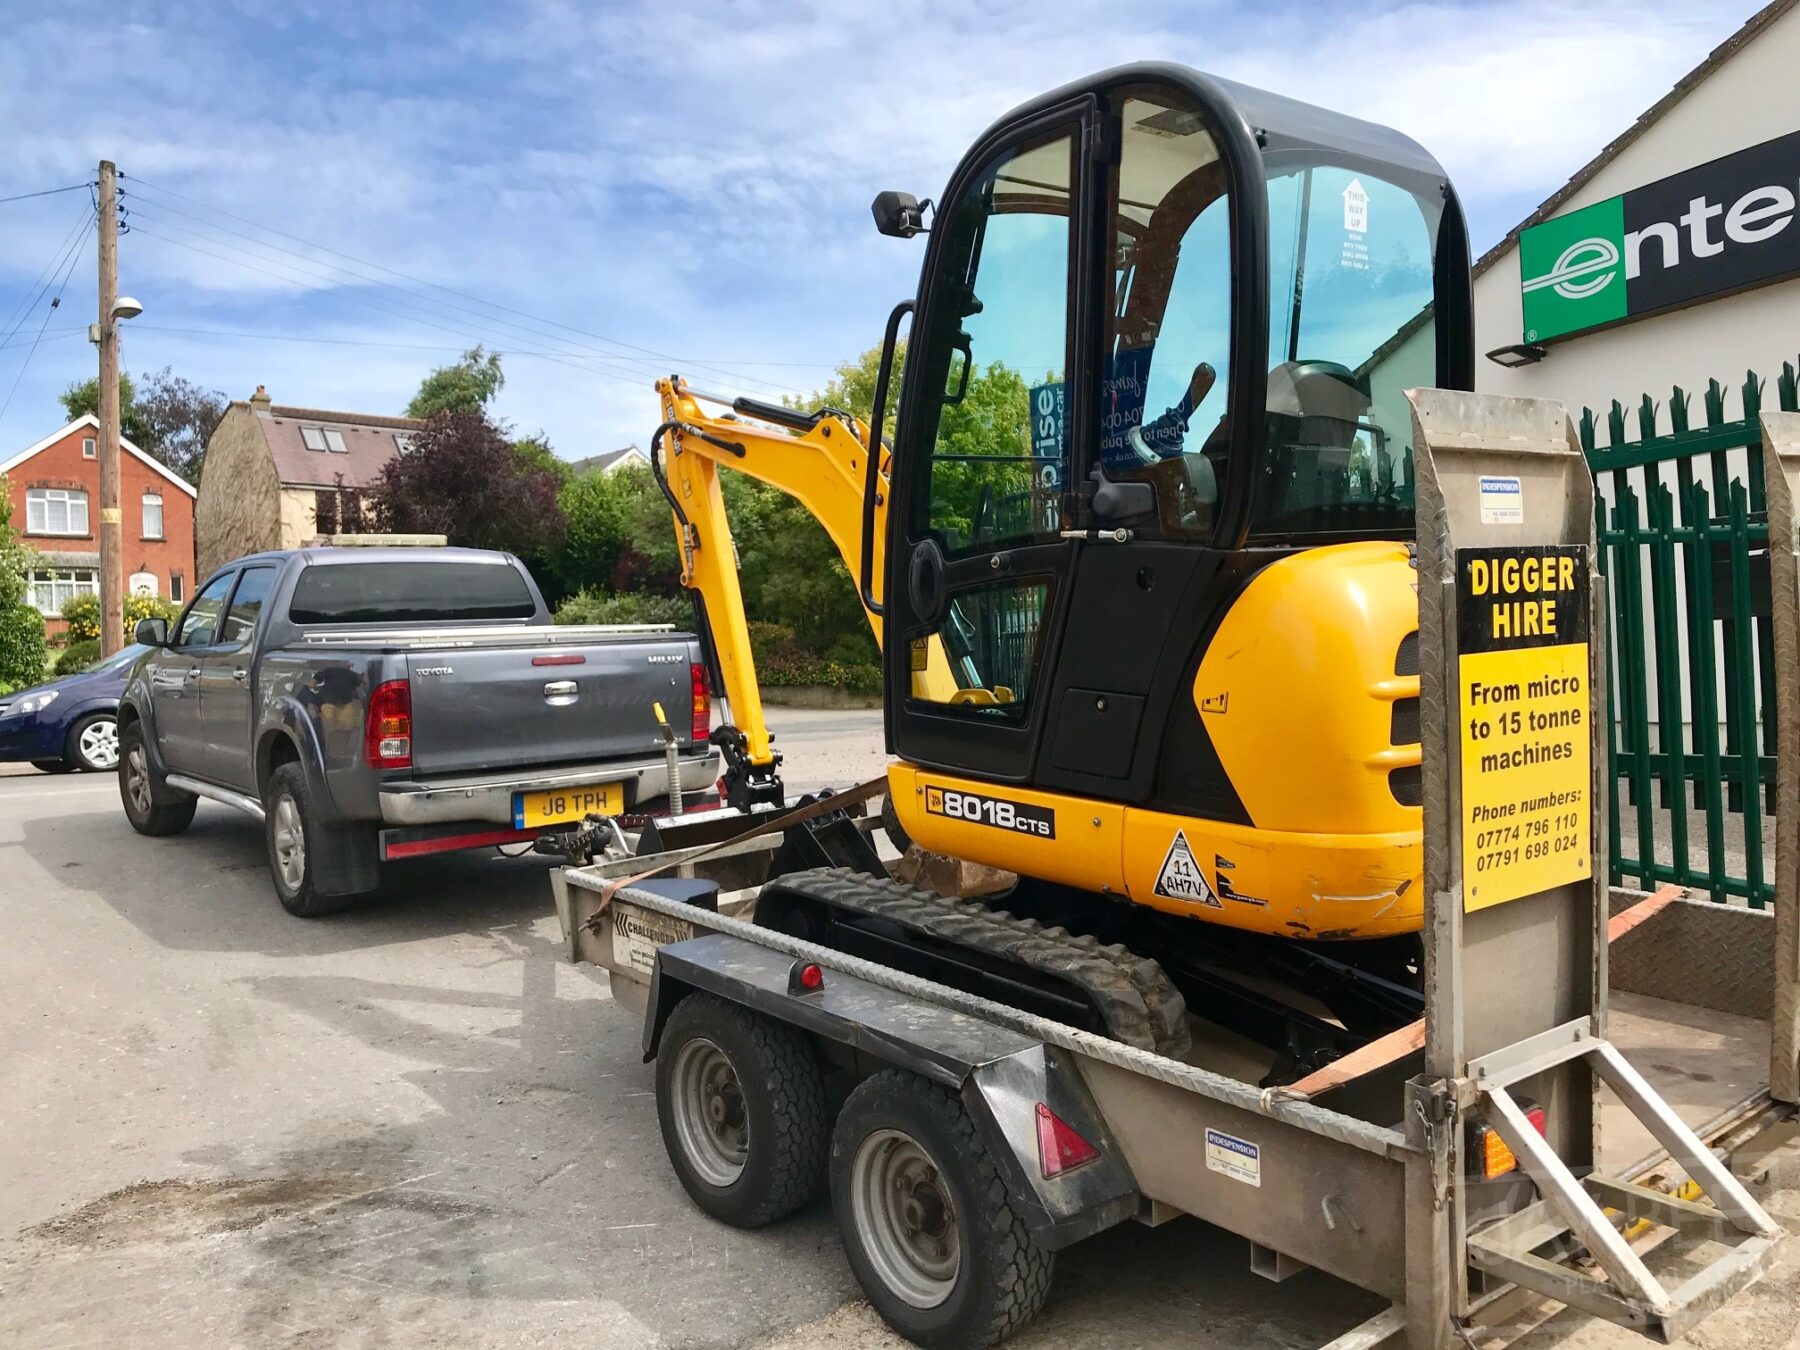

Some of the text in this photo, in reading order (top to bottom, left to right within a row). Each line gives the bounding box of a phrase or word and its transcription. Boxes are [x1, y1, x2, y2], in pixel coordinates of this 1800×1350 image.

[1348, 191, 1364, 202] THIS
[1349, 205, 1363, 215] WAY
[1351, 218, 1361, 228] UP
[1522, 185, 1800, 299] ente
[1471, 557, 1575, 595] DIGGER
[1493, 600, 1557, 639] HIRE
[416, 666, 454, 677] TOYOTA
[1470, 674, 1580, 706] From micro
[1470, 708, 1581, 741] to 15 tonne
[1481, 741, 1573, 773] machines
[542, 791, 607, 816] J8 TPH
[1472, 789, 1582, 823] Phone numbers:
[1476, 812, 1578, 849] 07774 796 110
[1174, 859, 1192, 878] 11
[1476, 833, 1578, 872] 07791 698 024
[1166, 876, 1202, 896] AH7V
[1209, 1133, 1257, 1157] INDESPENSION
